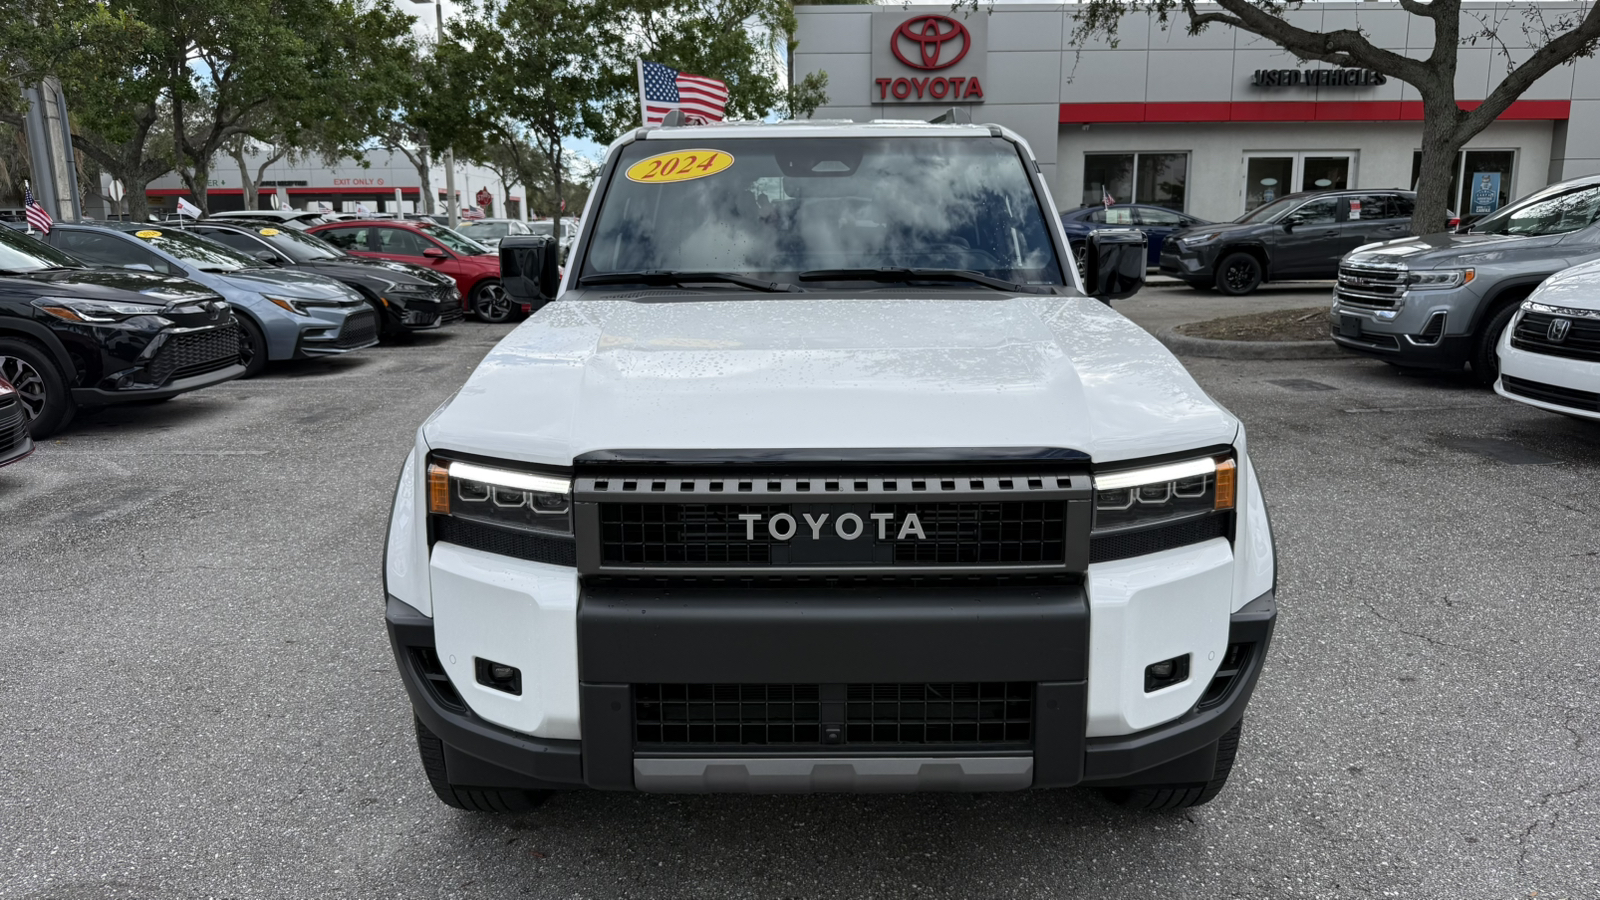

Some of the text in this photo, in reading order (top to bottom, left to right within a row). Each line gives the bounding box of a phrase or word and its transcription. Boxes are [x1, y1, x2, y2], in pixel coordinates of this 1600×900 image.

[875, 77, 984, 100] TOYOTA
[1253, 69, 1387, 87] USED VEHICLES
[640, 152, 719, 180] 2024
[333, 178, 375, 186] EXIT ONLY
[738, 512, 926, 541] TOYOTA
